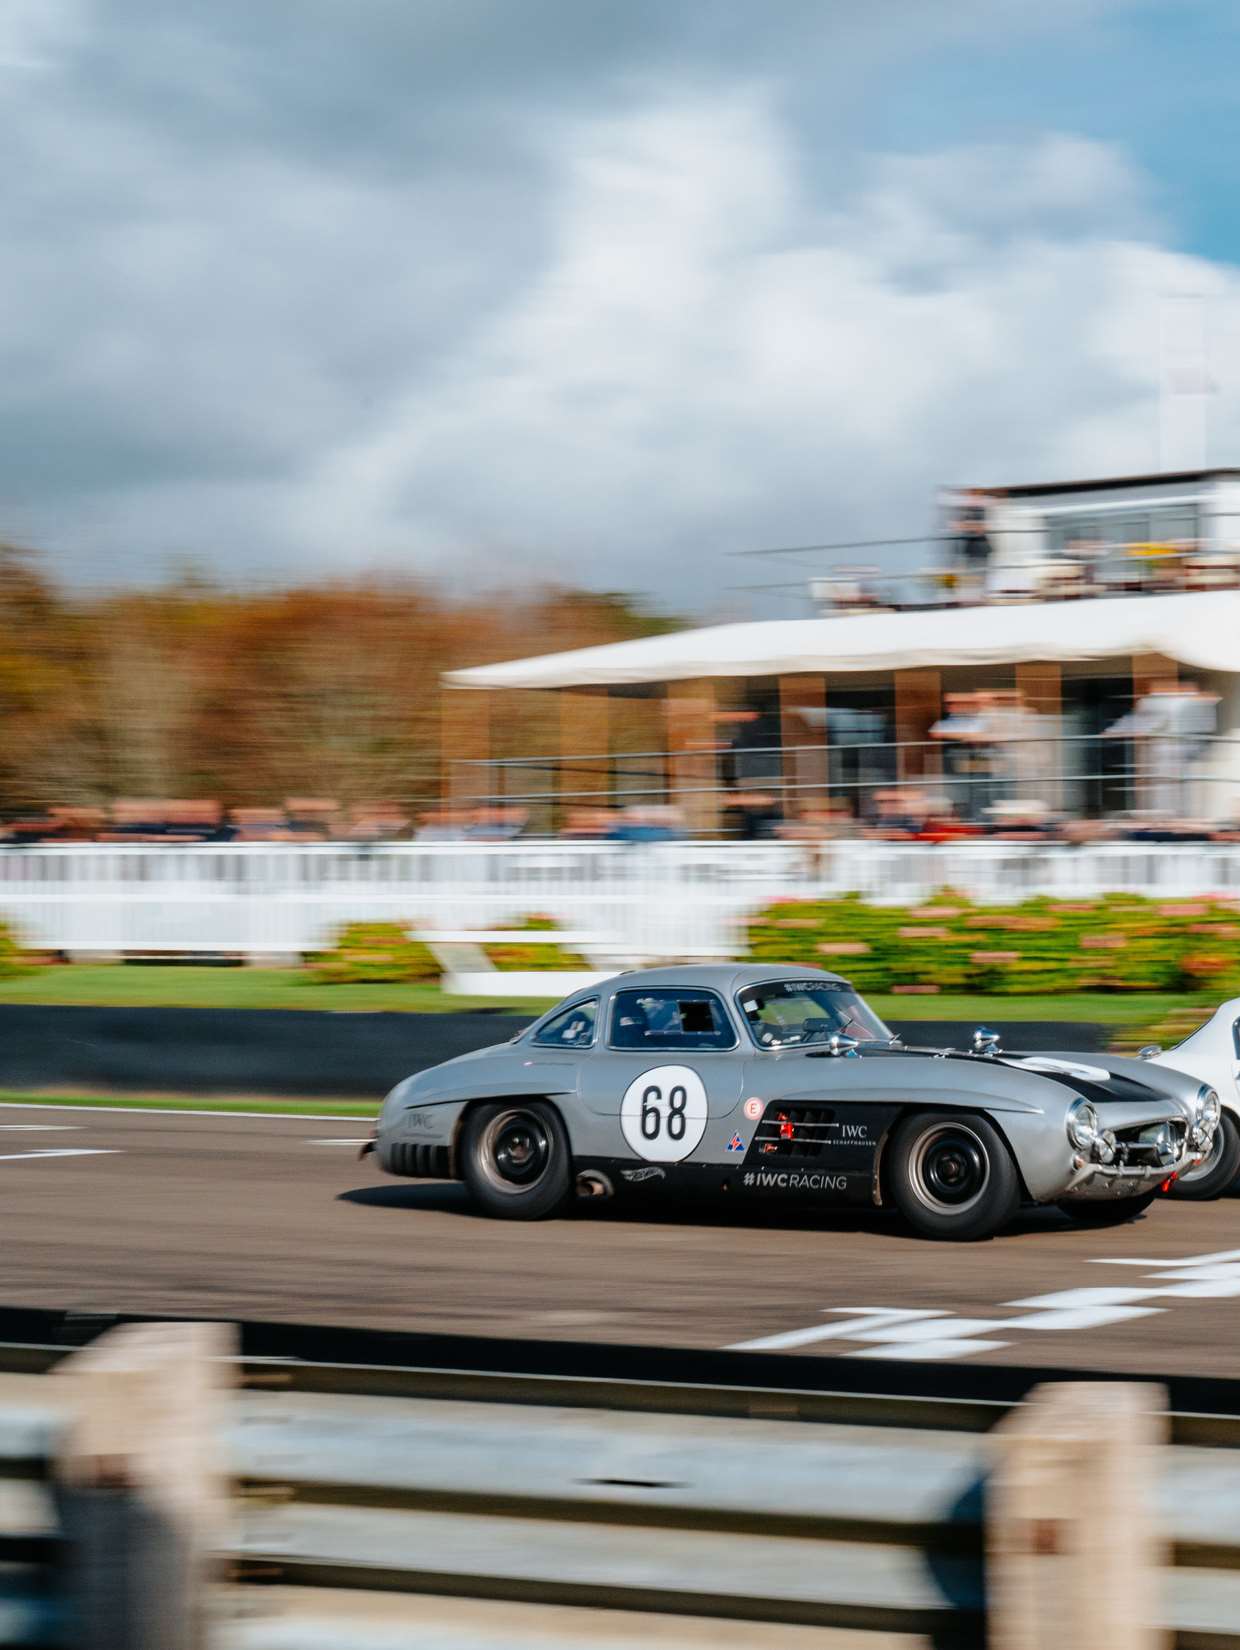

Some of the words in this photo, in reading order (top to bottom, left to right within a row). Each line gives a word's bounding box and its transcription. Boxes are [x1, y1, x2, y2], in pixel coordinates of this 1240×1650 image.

[641, 1085, 687, 1140] 68
[750, 1103, 758, 1114] E
[842, 1125, 867, 1138] IWC
[744, 1172, 847, 1190] #IWCRACING
